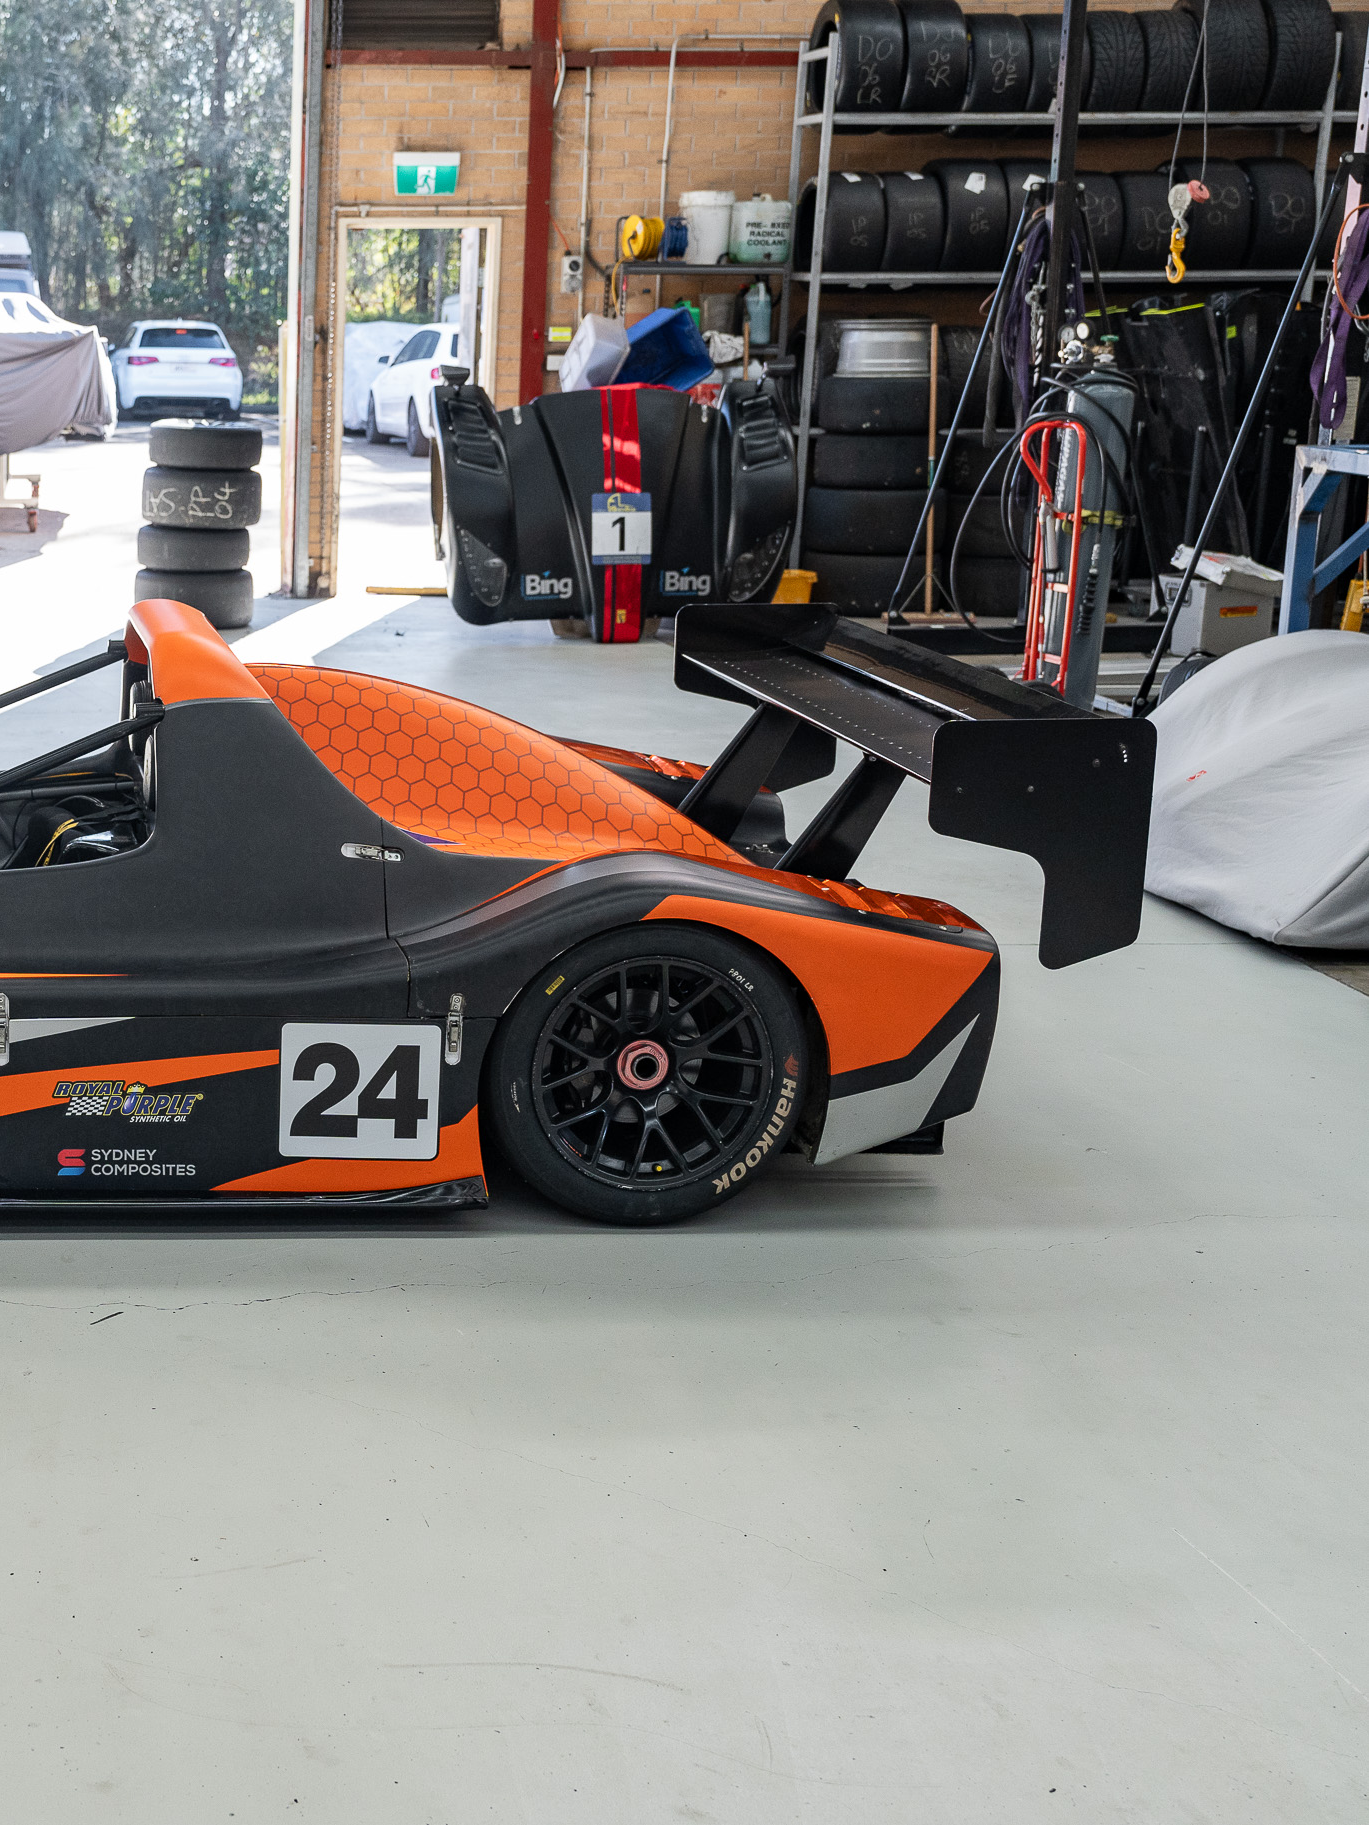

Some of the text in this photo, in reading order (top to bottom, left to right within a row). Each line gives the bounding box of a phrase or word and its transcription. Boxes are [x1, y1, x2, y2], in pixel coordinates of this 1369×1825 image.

[857, 34, 893, 63] DO
[749, 230, 786, 238] RADICAL
[746, 239, 786, 247] COOLANT
[611, 516, 626, 552] 1
[524, 571, 573, 599] Bing
[664, 568, 711, 596] Bing
[53, 1082, 124, 1097] ROYAL
[289, 1042, 429, 1139] 24
[129, 1115, 187, 1123] SYNTHETIC OIL
[91, 1149, 157, 1161] SYDNEY
[91, 1164, 196, 1176] COMPOSITES
